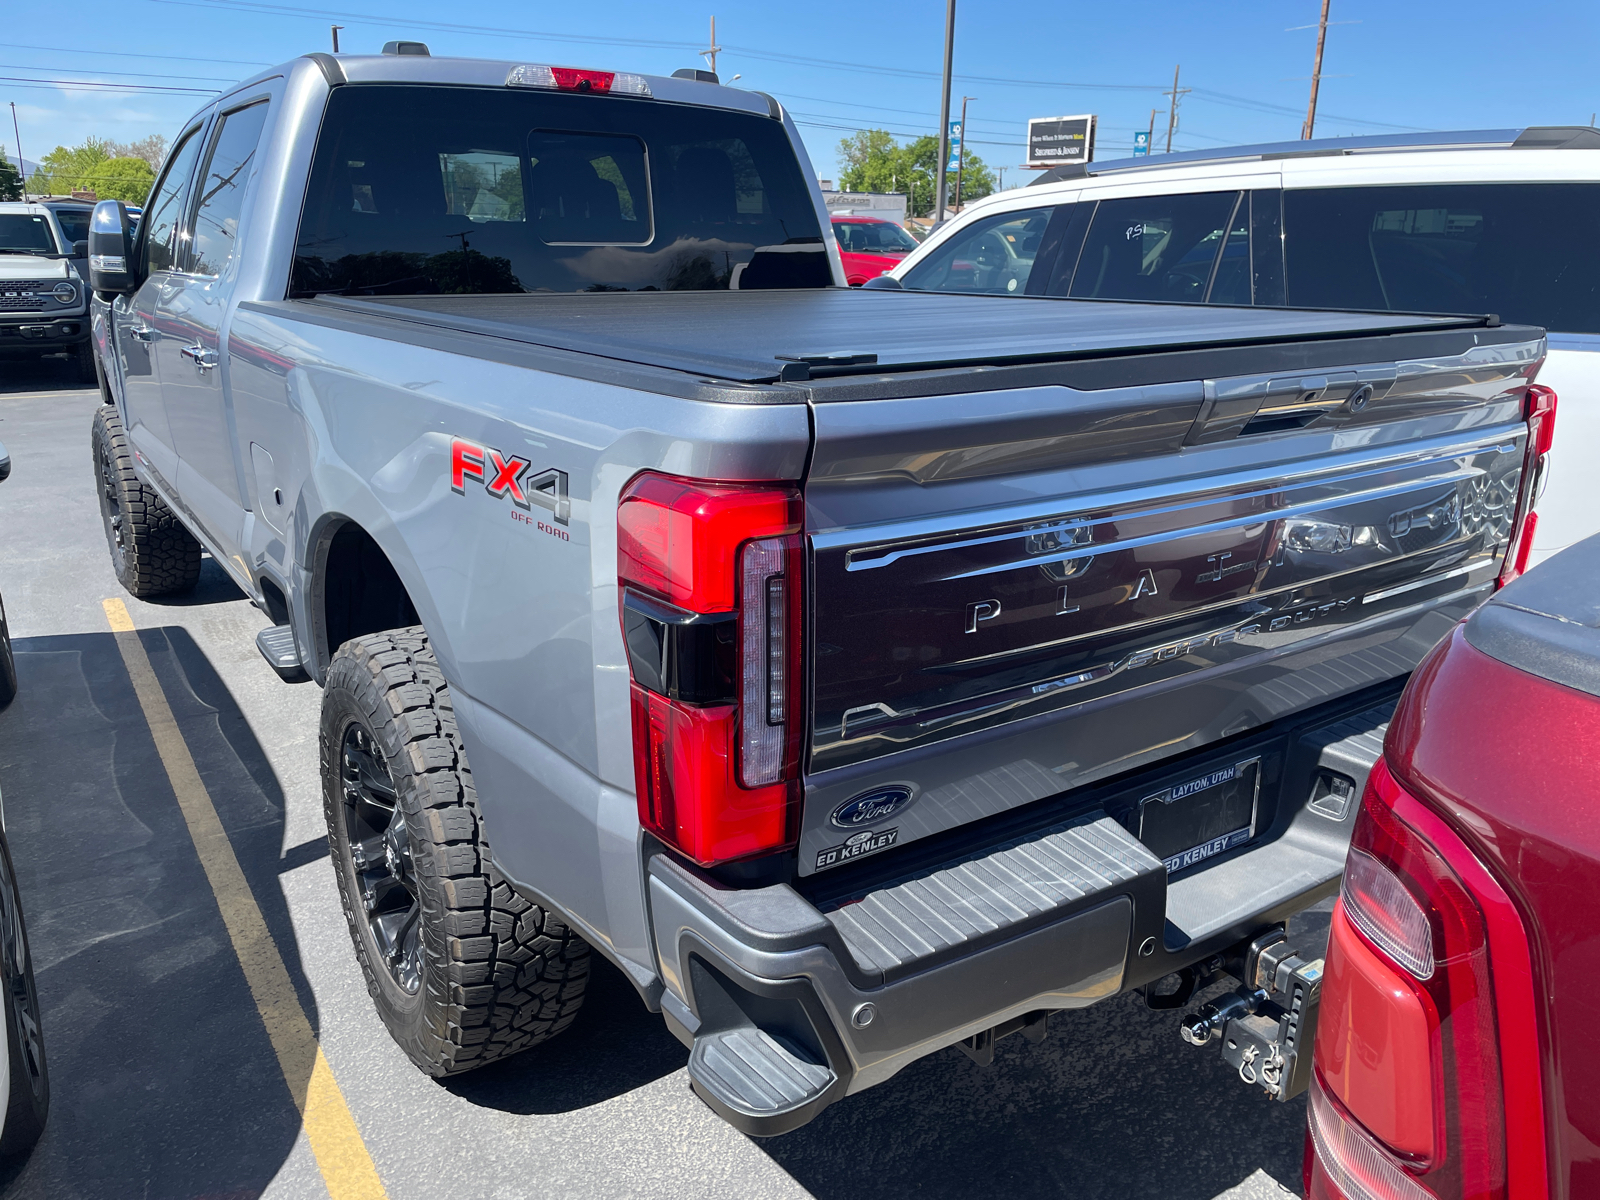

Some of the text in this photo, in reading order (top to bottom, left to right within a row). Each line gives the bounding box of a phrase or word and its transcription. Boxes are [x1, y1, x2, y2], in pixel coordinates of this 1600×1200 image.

[451, 435, 571, 527] FX4
[511, 510, 570, 542] OFF ROAD
[1127, 597, 1356, 670] SUPER DUTY
[1172, 768, 1235, 799] LAYTON, UTAH
[853, 796, 898, 822] Ford
[817, 832, 897, 867] ED KENLEY
[1183, 837, 1230, 866] KENLEY
